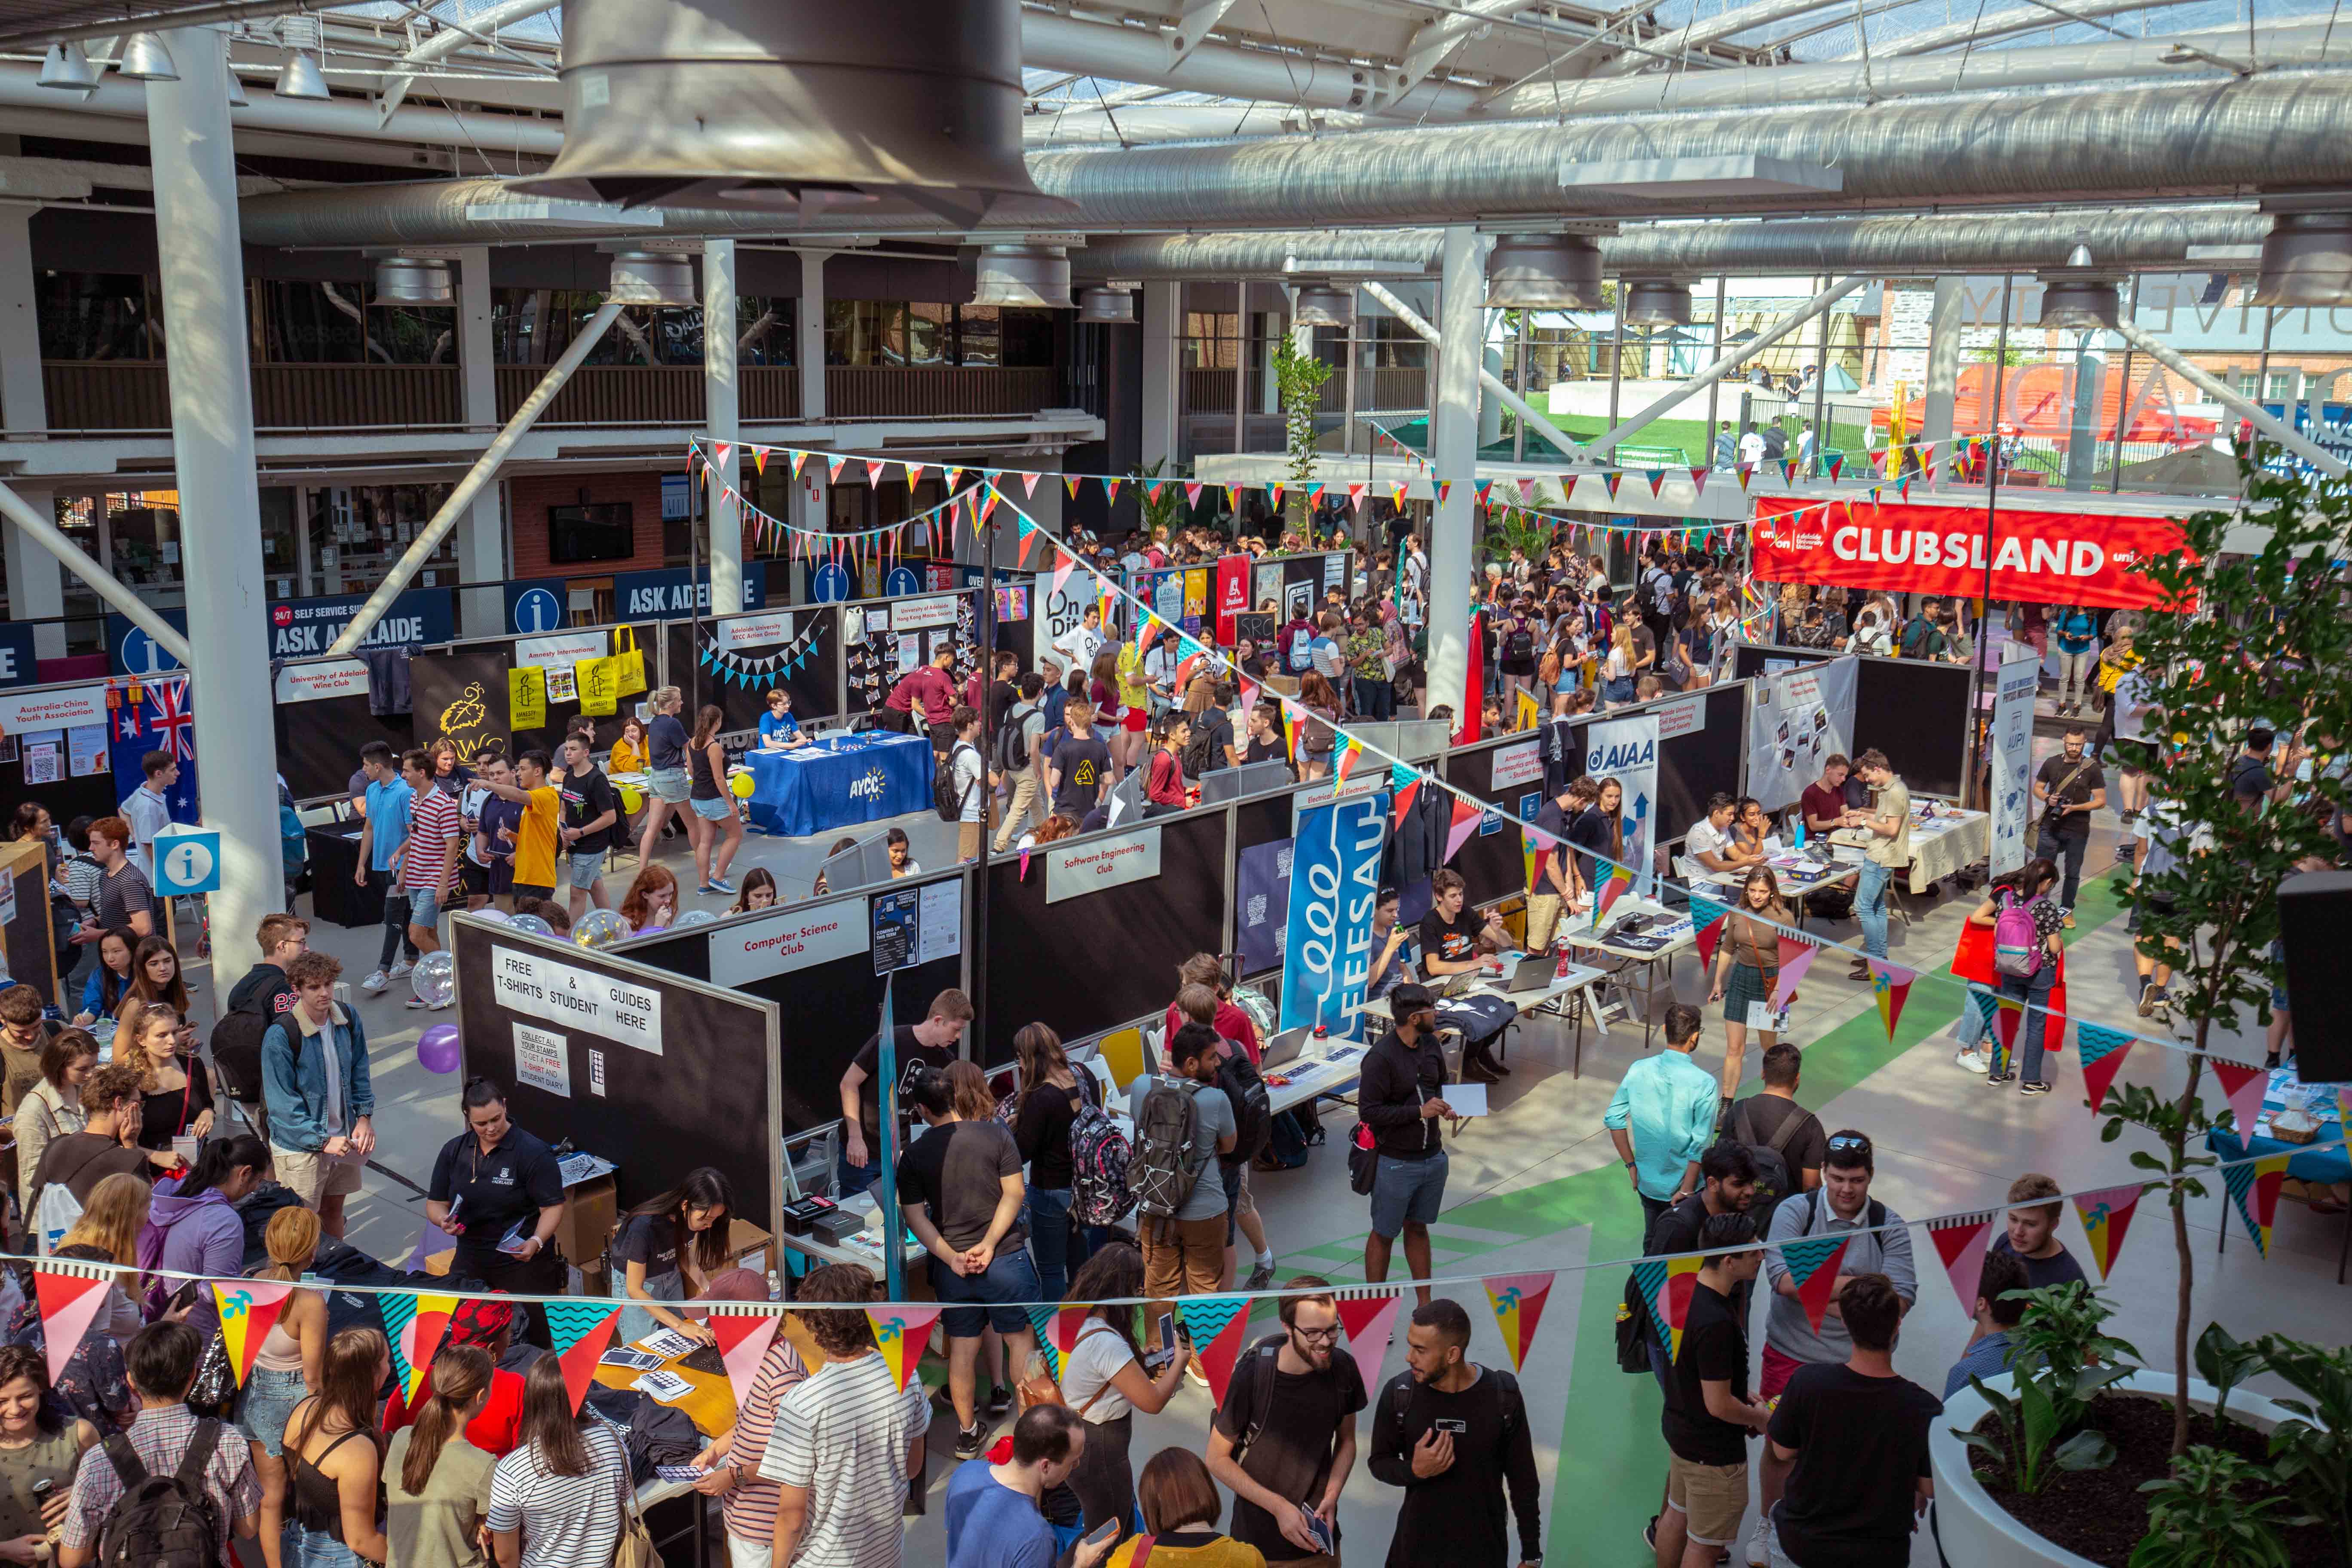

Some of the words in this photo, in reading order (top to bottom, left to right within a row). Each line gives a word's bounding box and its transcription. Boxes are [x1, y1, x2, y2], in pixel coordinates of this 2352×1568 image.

[1796, 539, 1824, 547] University
[1832, 525, 2104, 577] CLUBSLAND
[968, 575, 1002, 587] OVEREAS
[629, 586, 665, 614] ASK
[1046, 589, 1079, 621] On
[1226, 596, 1243, 606] Student
[275, 611, 291, 621] 24/7
[295, 609, 314, 619] SELF
[315, 606, 347, 618] SERVICE
[731, 625, 754, 634] Adelaide
[755, 623, 781, 631] University
[1241, 618, 1272, 637] SRC
[276, 625, 319, 654] ASK
[1085, 637, 1099, 650] On
[529, 650, 555, 659] Amnesty
[557, 646, 596, 655] International
[290, 673, 327, 683] University
[312, 681, 332, 689] Wine
[20, 700, 89, 714] Australia-China
[590, 700, 608, 708] AMNESTY
[1660, 708, 1675, 717] delaide
[1675, 703, 1697, 715] University
[15, 714, 41, 723] Youth
[44, 708, 94, 720] Association
[516, 710, 536, 718] AMNESTY
[1670, 714, 1693, 725] Engineering
[772, 728, 788, 739] AYCC
[1659, 725, 1675, 735] Student
[1675, 722, 1692, 732] Society
[2007, 732, 2026, 750] AUPI
[1505, 751, 1528, 762] American
[1529, 749, 1540, 758] Inst
[1602, 739, 1654, 770] AIAA
[1495, 763, 1524, 775] Aeronautics
[1513, 769, 1531, 779] Student
[849, 777, 879, 799] AYCC
[1308, 793, 1333, 804] Electrical
[1346, 784, 1371, 796] Electronic
[1064, 855, 1099, 870] Software
[1101, 842, 1145, 863] Engineering
[1096, 863, 1114, 875] Club
[744, 932, 798, 952] Computer
[800, 921, 839, 939] Science
[780, 942, 805, 956] Club
[505, 958, 532, 977] FREE
[569, 977, 577, 990] &
[610, 988, 652, 1012] GUIDES
[497, 977, 543, 1000] T-SHIRTS
[550, 993, 598, 1017] STUDENT
[616, 1011, 646, 1031] HERE
[521, 1031, 545, 1043] COLLECT
[546, 1038, 557, 1047] ALL
[521, 1040, 535, 1050] YOUR
[536, 1045, 557, 1057] STAMPS
[520, 1050, 527, 1058] TO
[528, 1053, 539, 1061] GET
[545, 1058, 561, 1069] FREE
[524, 1061, 544, 1073] T-SHIRT
[545, 1069, 558, 1078] AND
[521, 1070, 545, 1084] STUDENT
[546, 1078, 564, 1090] DIARY
[665, 1248, 676, 1256] UNIV
[585, 1400, 594, 1410] THE
[586, 1409, 594, 1418] OF
